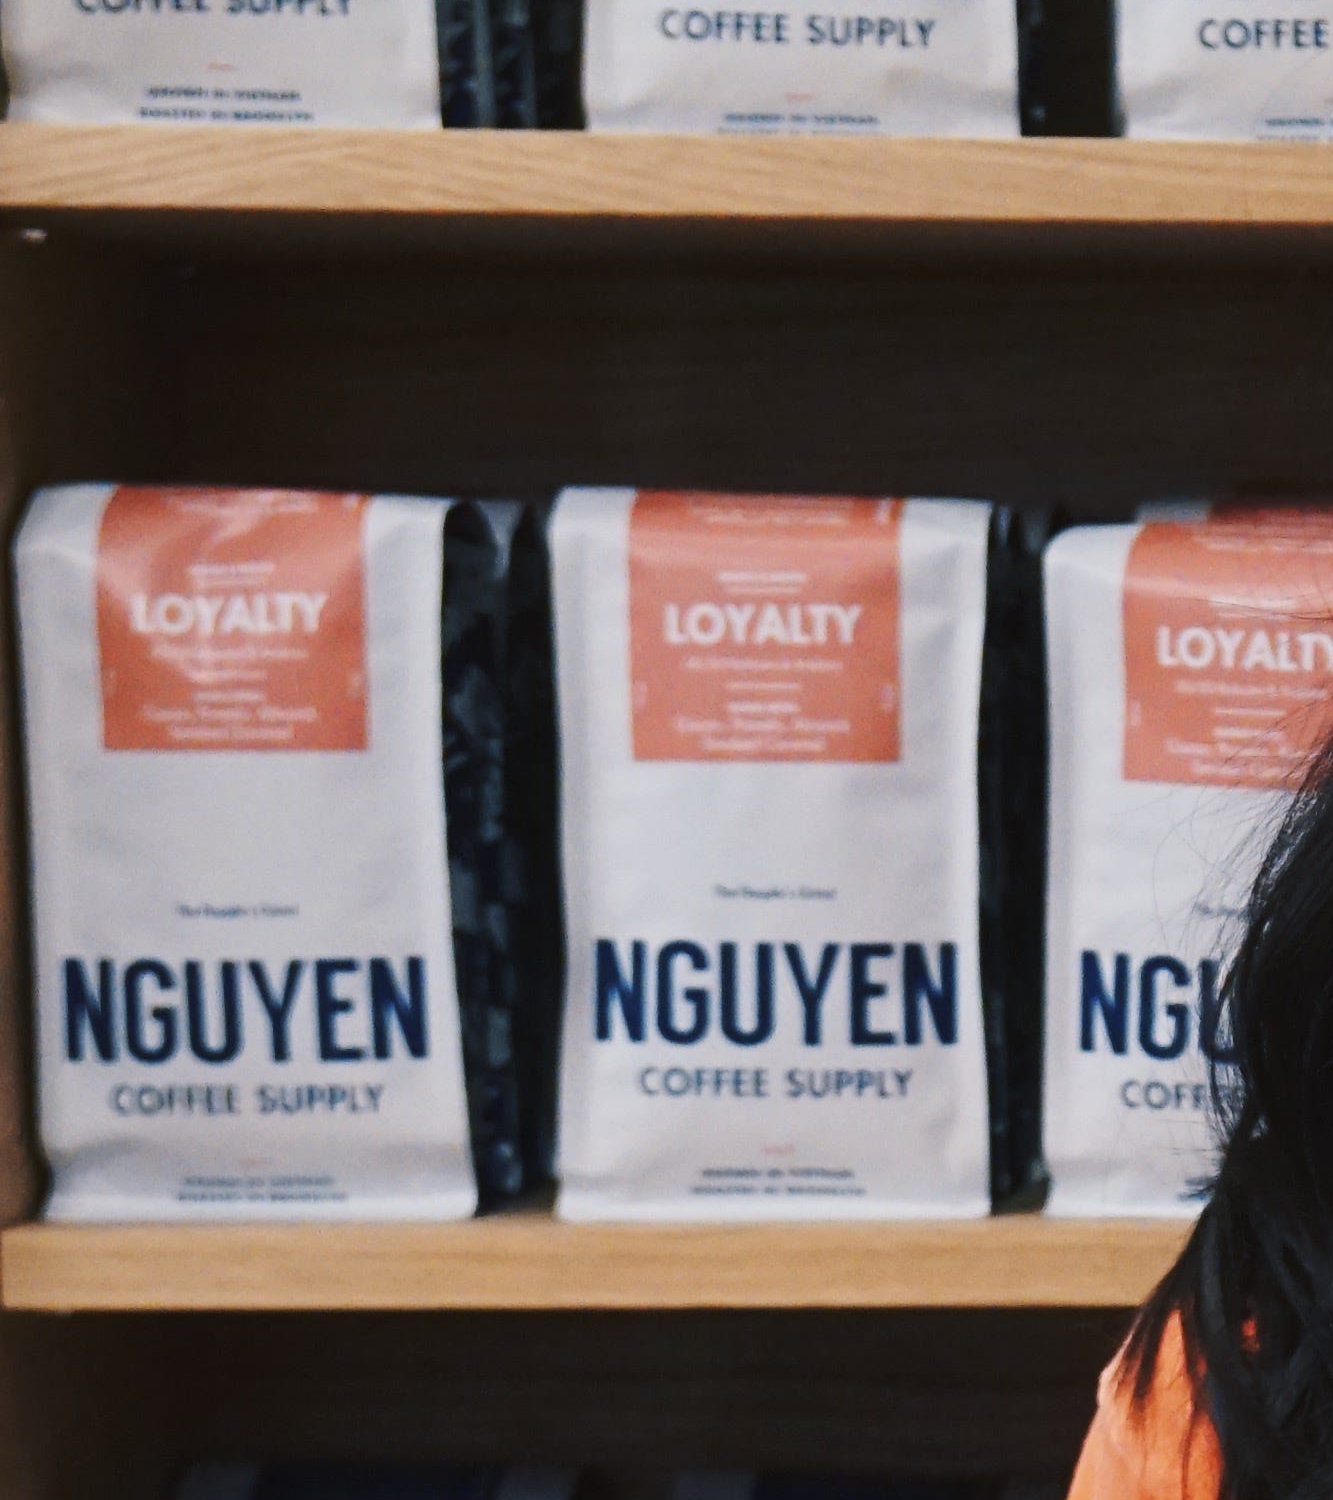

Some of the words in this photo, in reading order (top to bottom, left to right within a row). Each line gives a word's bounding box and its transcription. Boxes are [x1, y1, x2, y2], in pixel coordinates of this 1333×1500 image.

[658, 8, 790, 43] COFFEE
[806, 13, 936, 48] SUPPLY
[1198, 17, 1330, 49] COFFEE
[128, 592, 328, 635] LOYALTY
[663, 602, 862, 646] LOYALTY
[63, 956, 429, 1064] NGUYEN
[594, 937, 959, 1047] NGUYEN
[111, 1083, 241, 1116] COFFEE
[256, 1084, 385, 1116] SUPPLY
[640, 1067, 769, 1098] COFFEE
[786, 1068, 914, 1100] SUPPLY
